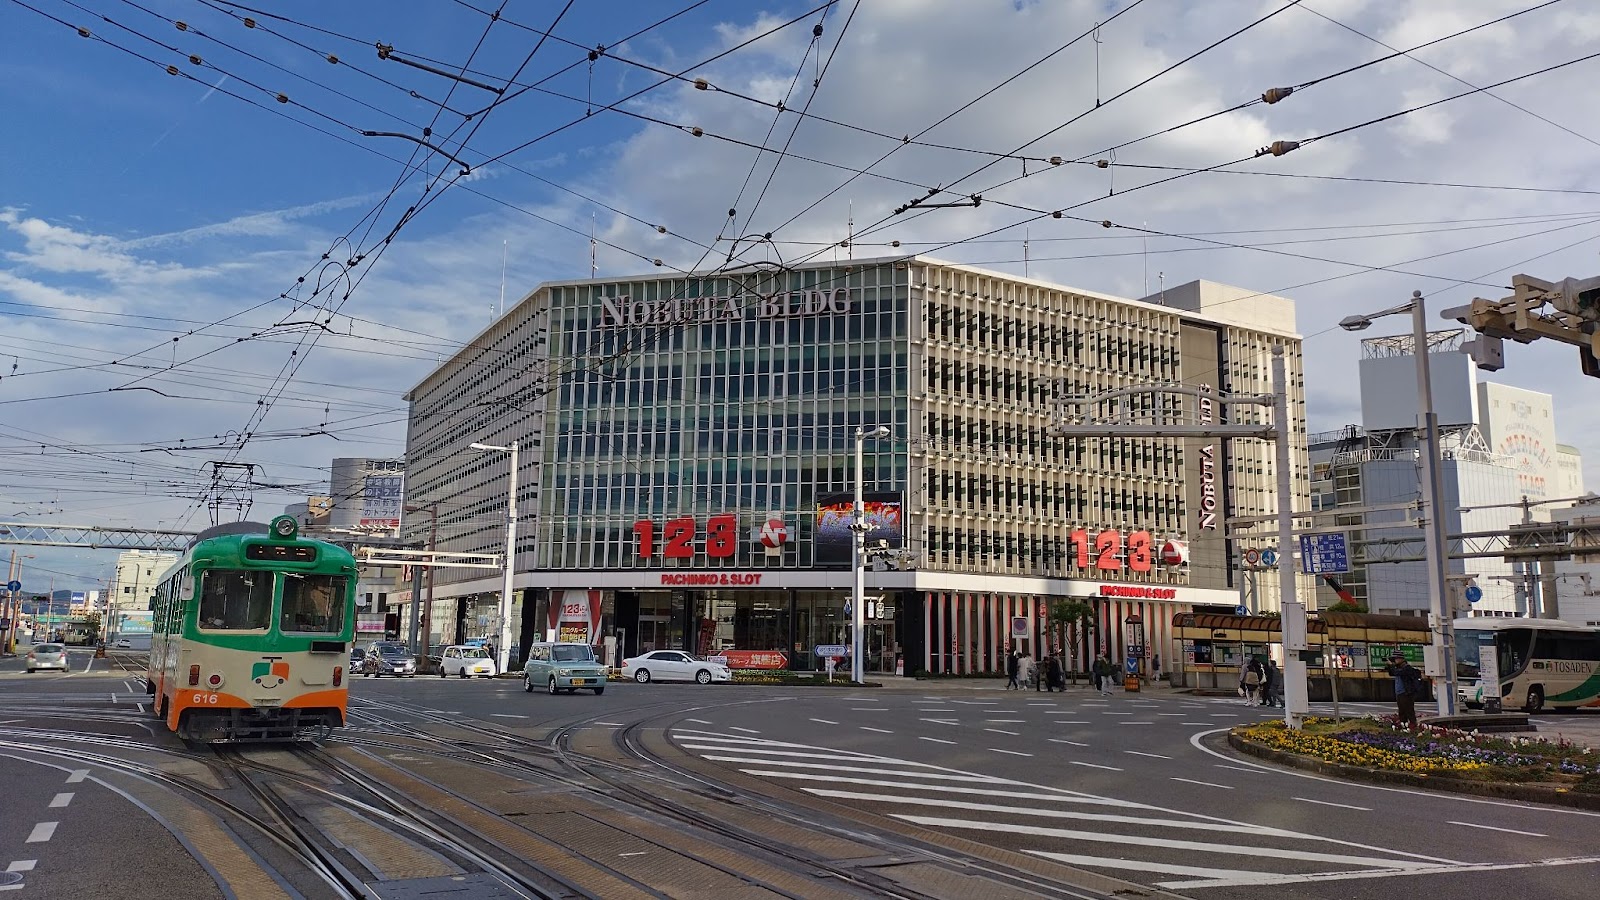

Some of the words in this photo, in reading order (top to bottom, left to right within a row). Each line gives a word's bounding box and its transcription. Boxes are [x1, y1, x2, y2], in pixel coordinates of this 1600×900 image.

[597, 295, 742, 328] NOBUTA
[756, 287, 852, 319] BLDG
[1199, 443, 1217, 531] NOBUTA
[633, 512, 736, 558] 123
[1070, 528, 1152, 572] 123
[661, 574, 719, 585] PACHINKO
[720, 574, 729, 585] &
[730, 574, 762, 585] SLOT
[1100, 586, 1146, 598] PACHINKO
[1153, 589, 1177, 599] SLOT
[562, 604, 580, 614] 123
[1554, 661, 1592, 673] TOSADEN
[192, 693, 218, 704] 616
